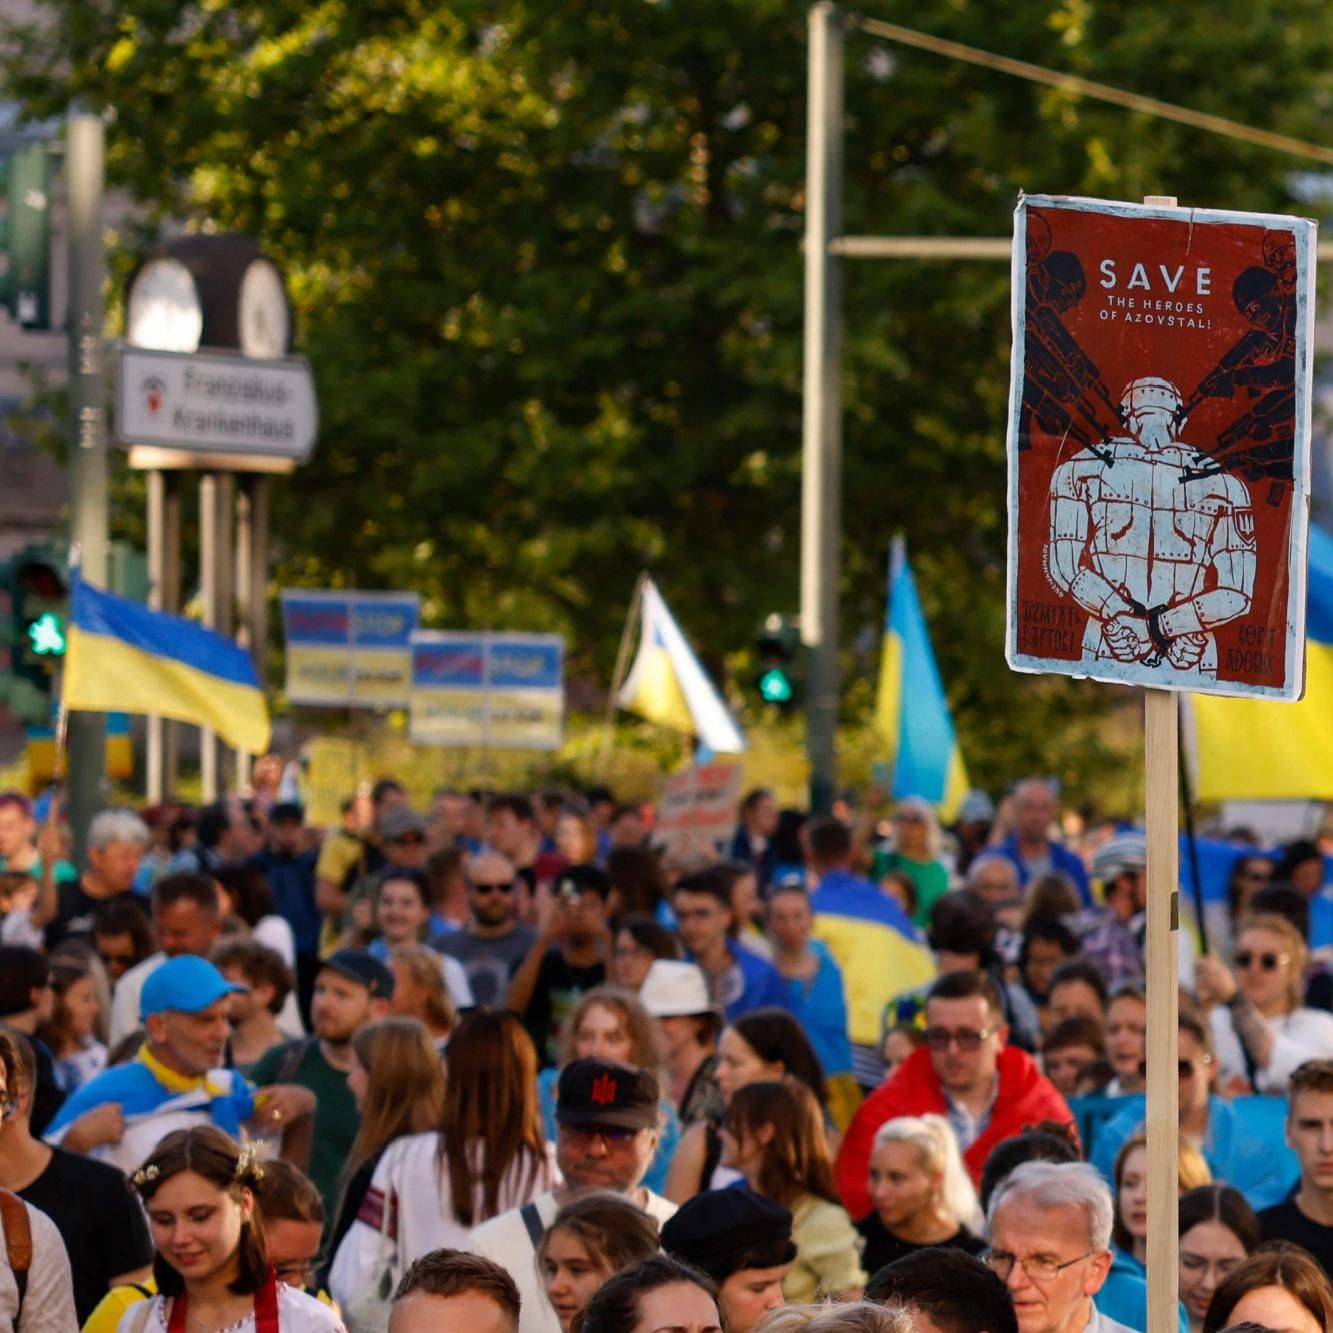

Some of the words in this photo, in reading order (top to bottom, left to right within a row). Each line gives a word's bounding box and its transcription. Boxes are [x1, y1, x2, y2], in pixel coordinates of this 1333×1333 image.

[1100, 259, 1211, 295] SAVE
[1107, 295, 1135, 308] THE
[1143, 299, 1203, 314] HEROES
[1099, 309, 1117, 320] OF
[1124, 312, 1211, 330] AZOVSTAL!
